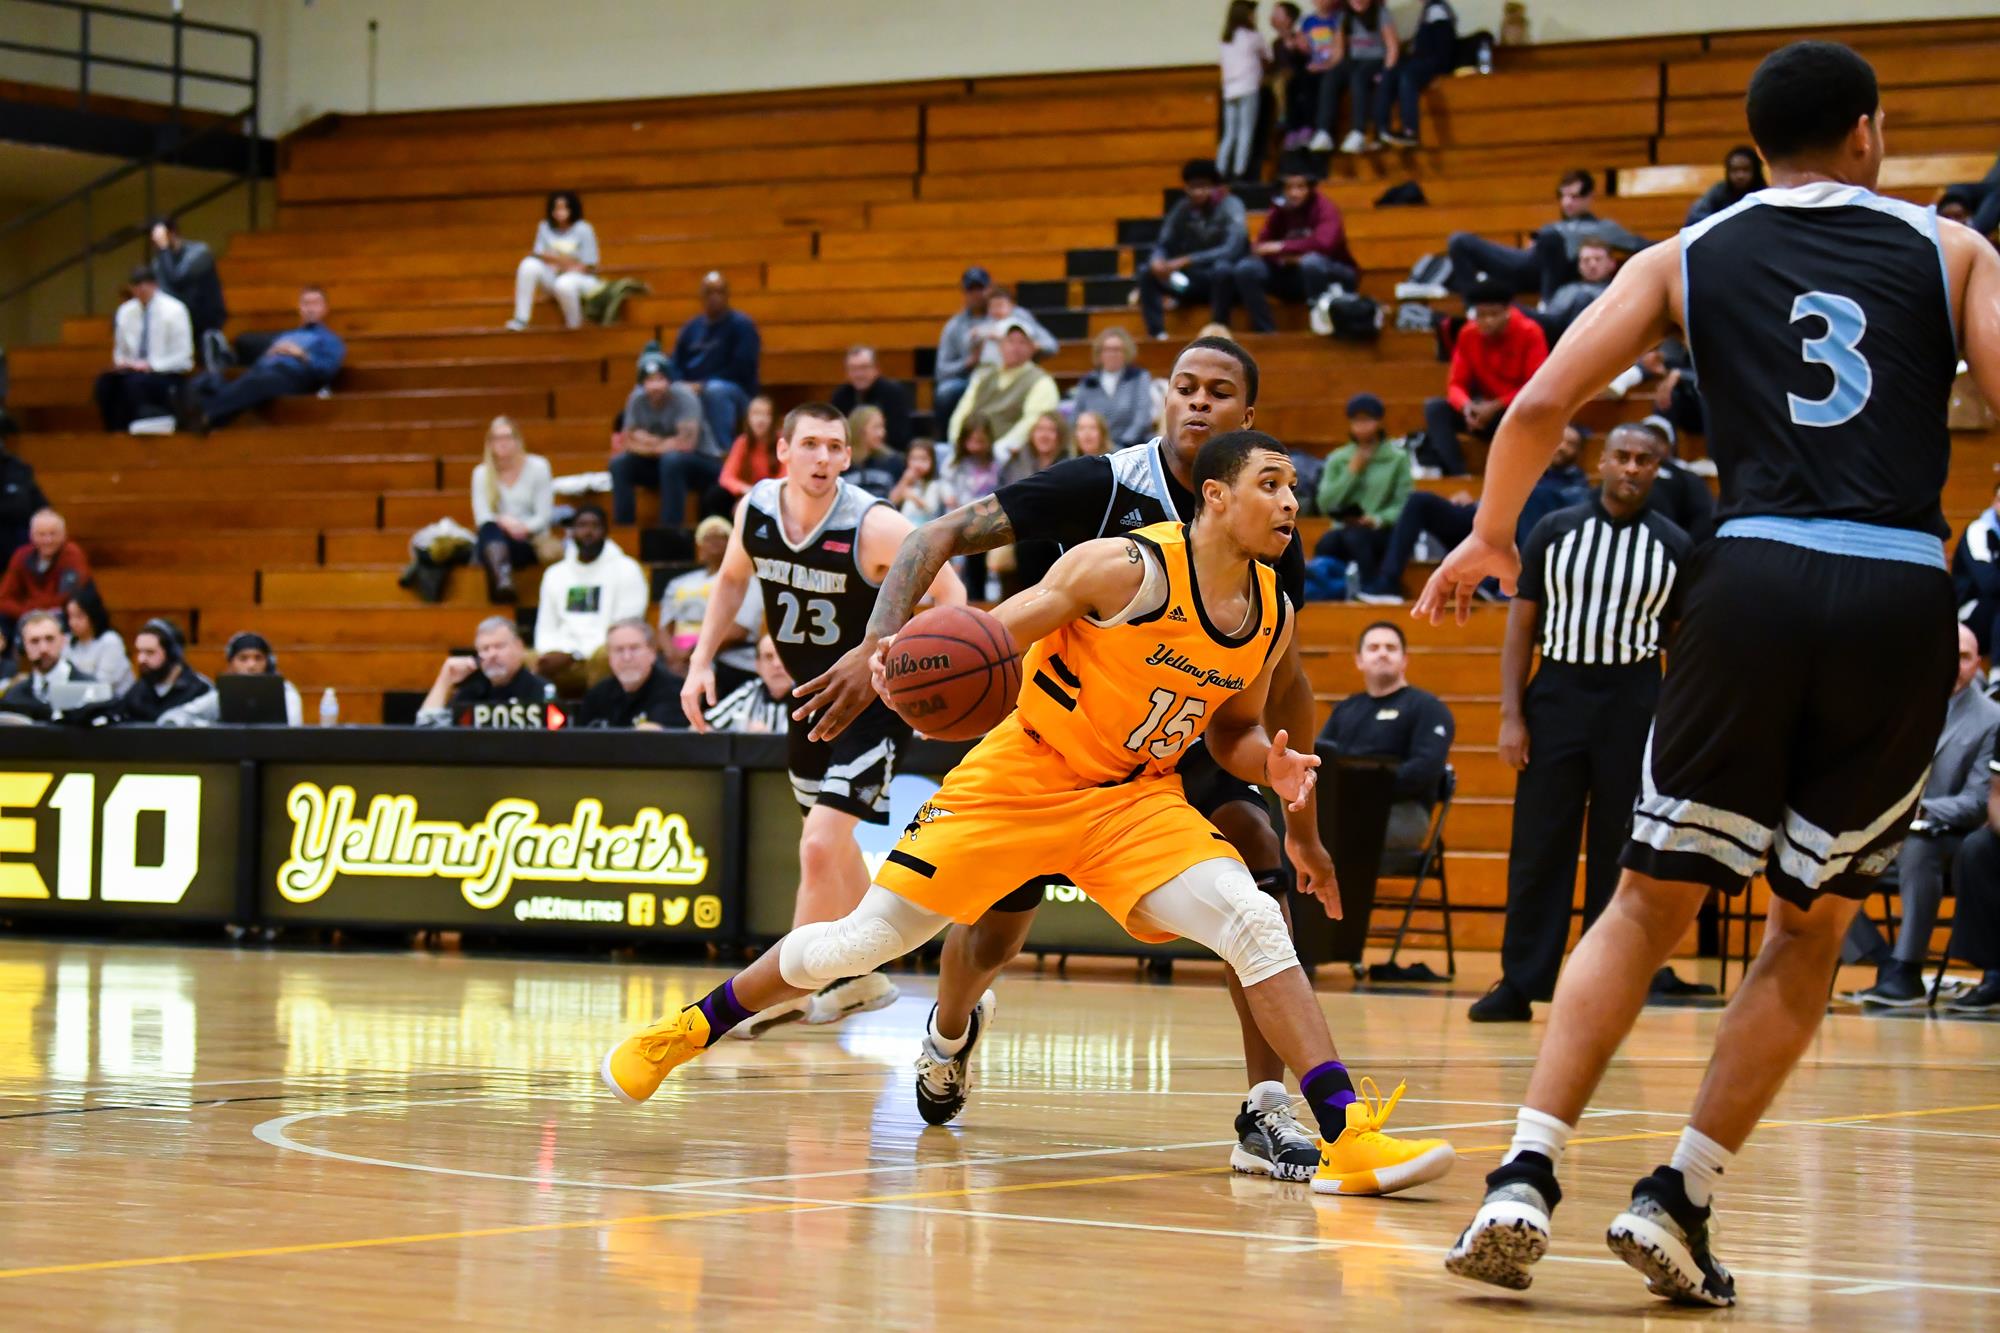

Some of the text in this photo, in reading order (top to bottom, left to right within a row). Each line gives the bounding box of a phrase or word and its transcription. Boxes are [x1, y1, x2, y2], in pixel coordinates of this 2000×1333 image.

[1786, 290, 1873, 429] 3
[776, 591, 841, 646] 23
[473, 703, 542, 730] POSS
[1123, 686, 1208, 760] 15
